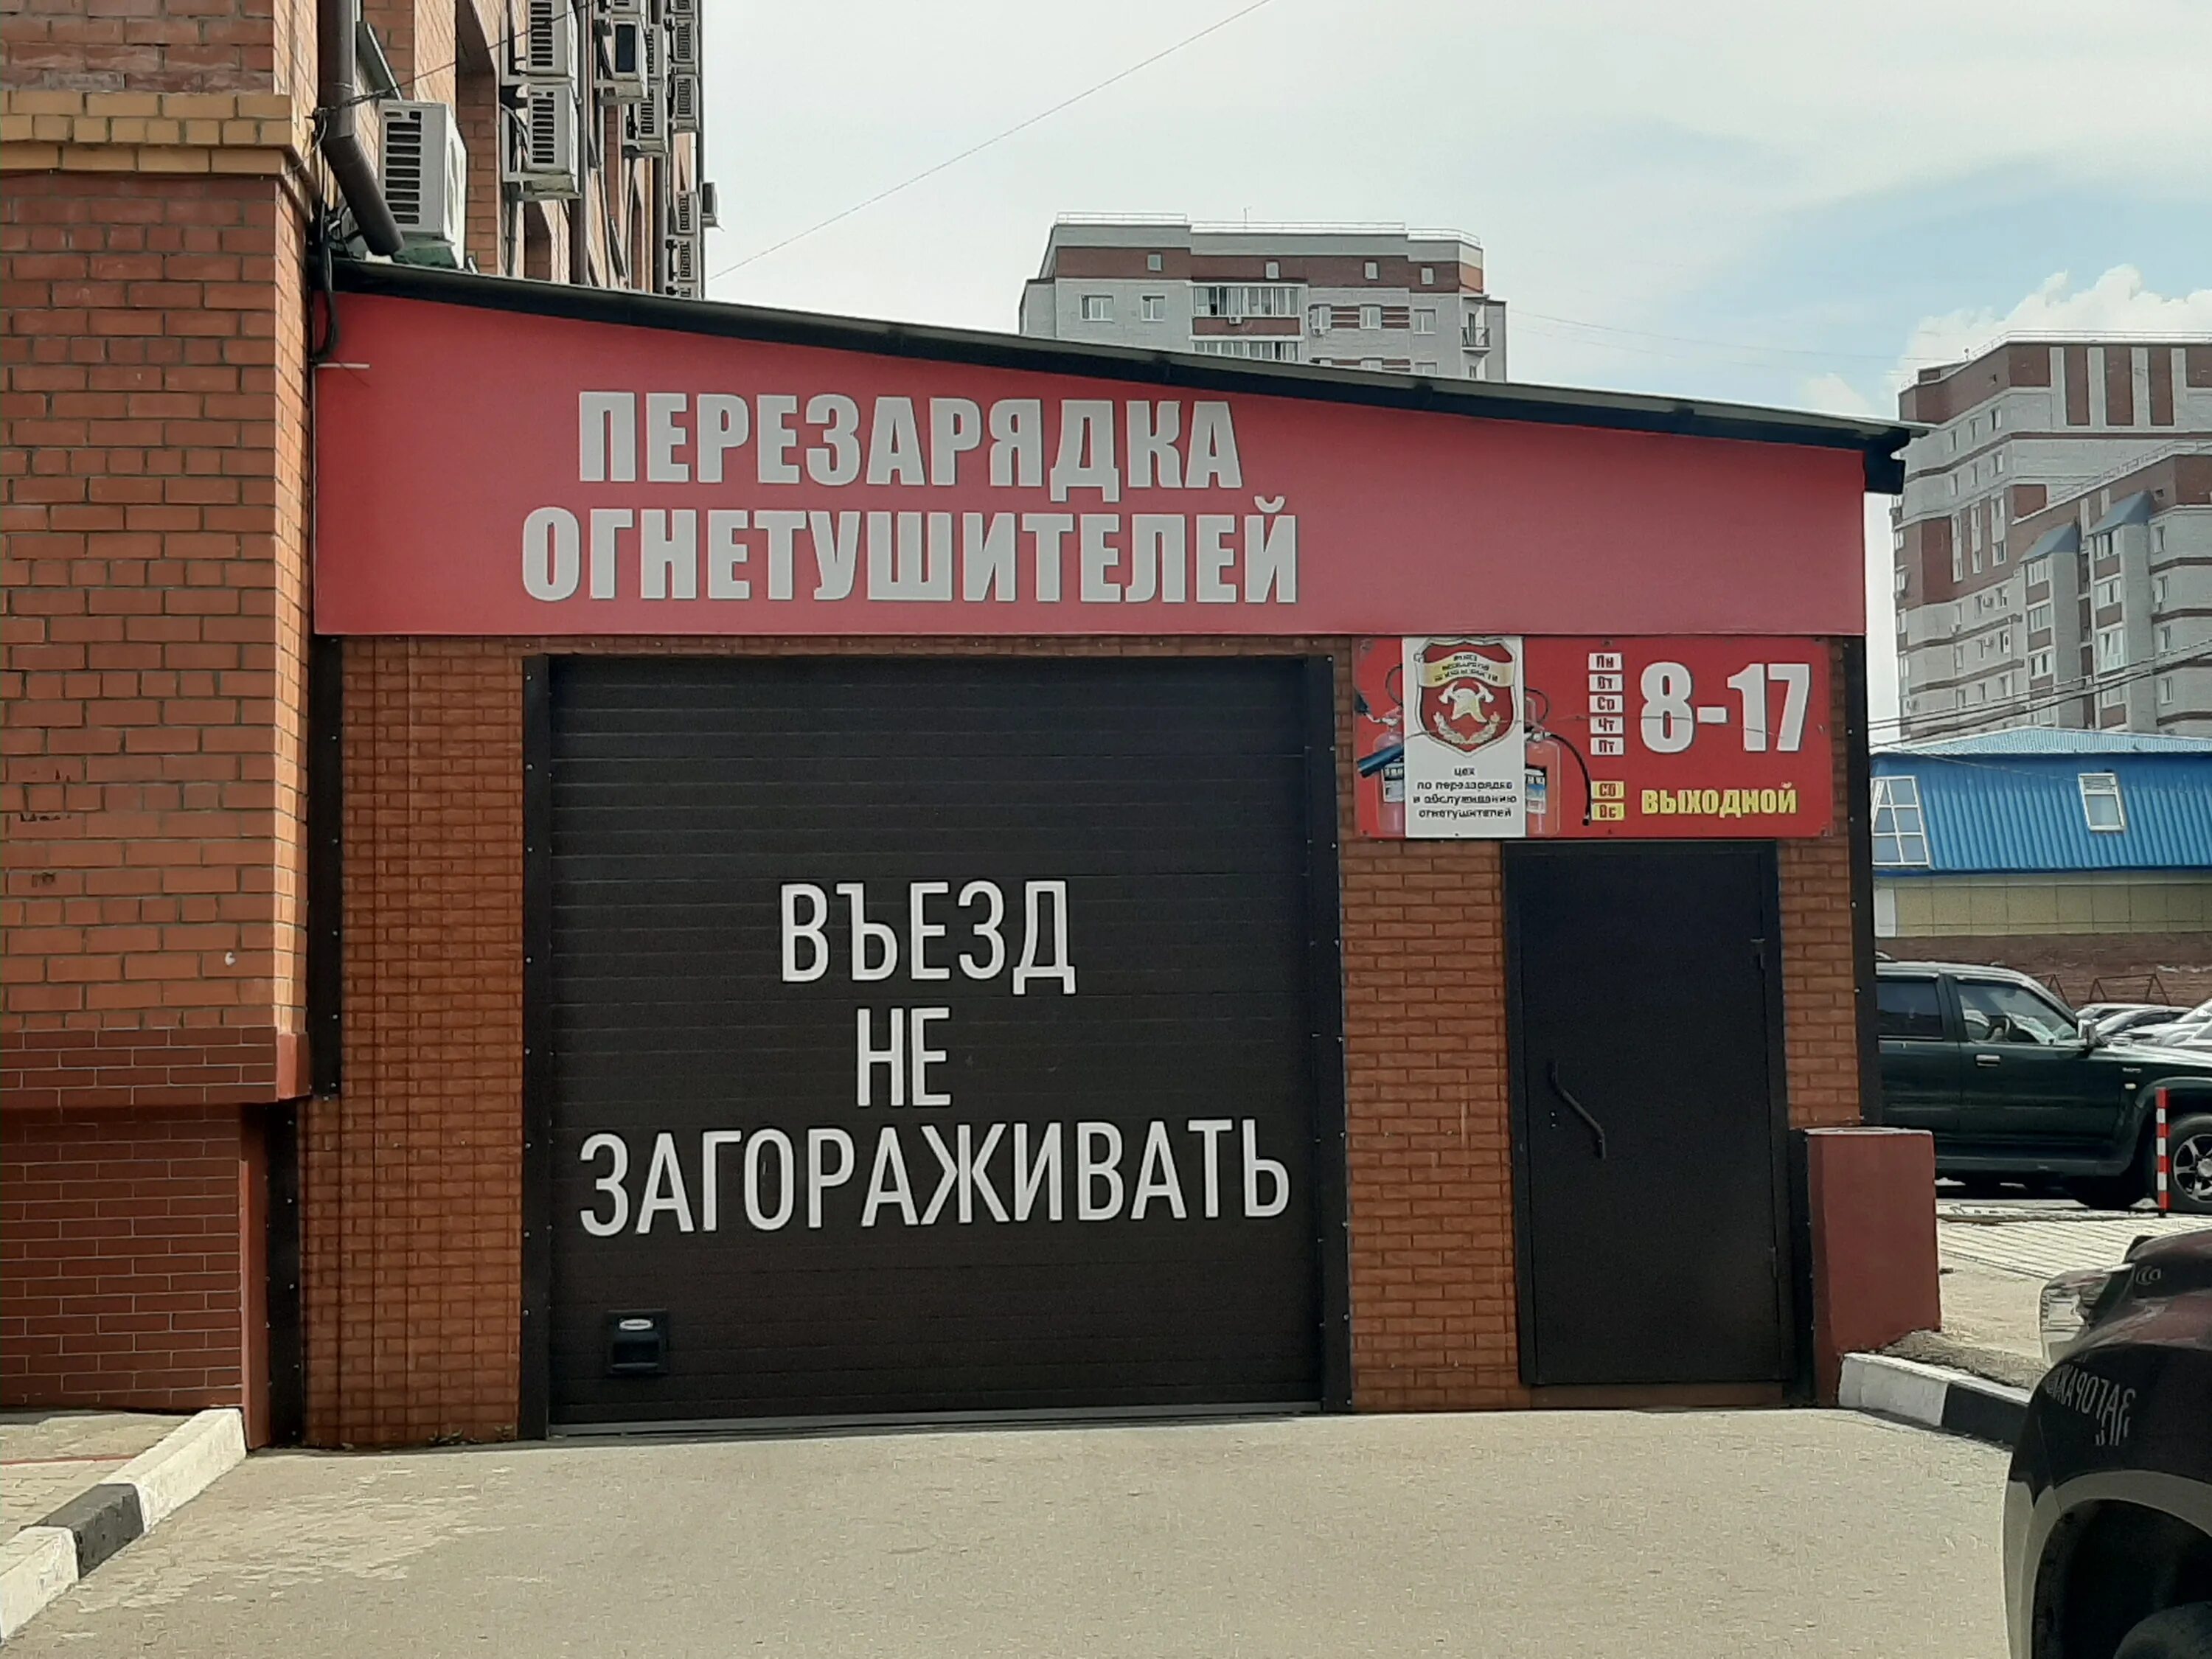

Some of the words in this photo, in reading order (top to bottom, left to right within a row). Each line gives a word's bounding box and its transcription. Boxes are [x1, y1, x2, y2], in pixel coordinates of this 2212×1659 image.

[578, 391, 1243, 503] ПЕРЕЗАРЯДКА
[522, 495, 1297, 603] ОГНЕТУШИТЕЛЕЙ
[1596, 655, 1615, 668] Пн
[1597, 696, 1615, 711] Ср
[1598, 718, 1615, 731] Чт
[1641, 661, 1810, 753] 8-17
[1599, 740, 1615, 753] Пт
[1417, 782, 1432, 790] по
[1641, 782, 1797, 818] ВЫХОДНОЙ
[781, 880, 1077, 995] ВЪЕЗД
[857, 1007, 951, 1106] НЕ
[580, 1119, 1290, 1236] ЗАГОРАЖИВАТЬ
